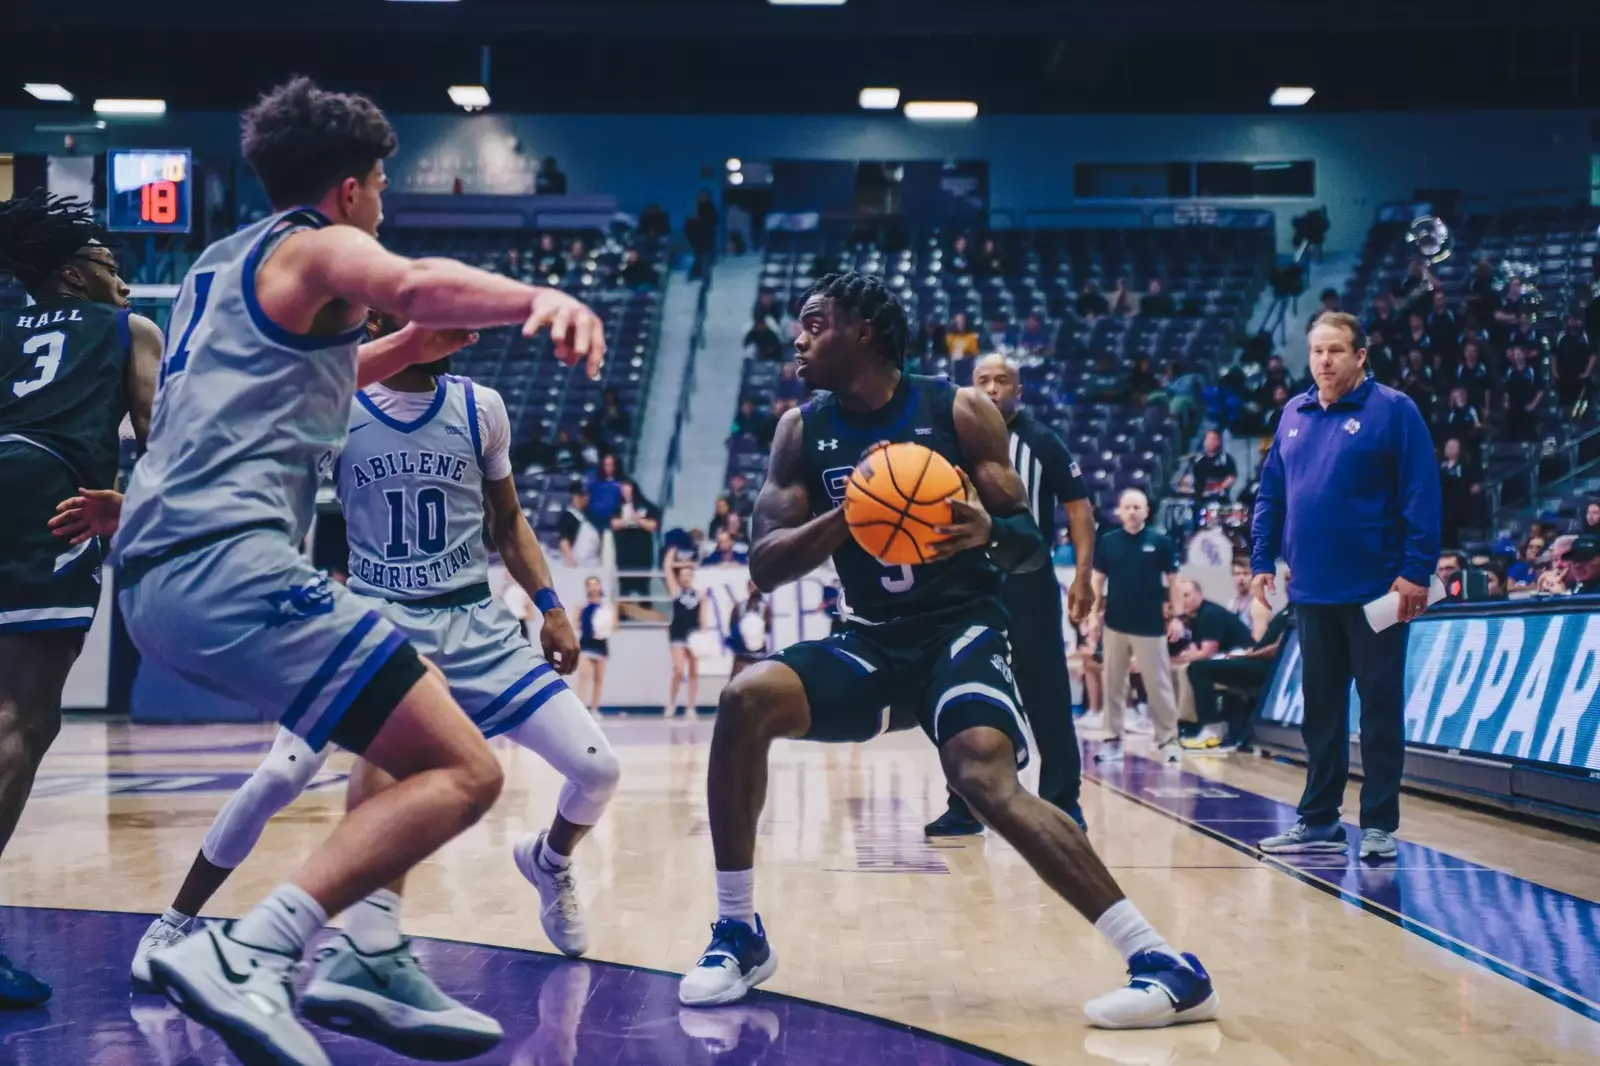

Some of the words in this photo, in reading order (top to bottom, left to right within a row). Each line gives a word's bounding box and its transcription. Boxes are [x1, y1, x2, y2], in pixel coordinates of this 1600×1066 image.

[141, 181, 176, 223] 18
[16, 309, 83, 328] HALL
[12, 331, 66, 398] 3
[352, 450, 469, 489] ABILENE
[383, 486, 448, 560] 10
[359, 541, 472, 589] CHRISTIAN
[1404, 613, 1600, 769] APPAR
